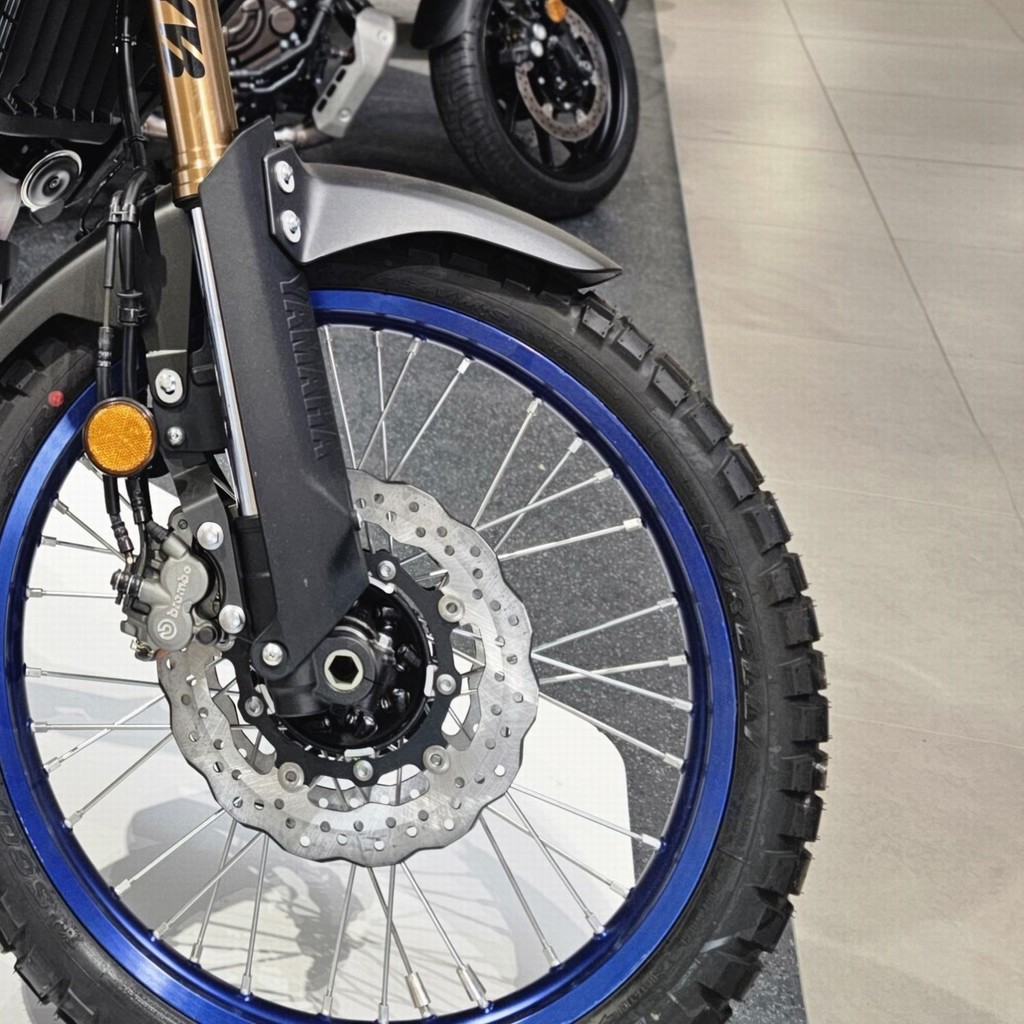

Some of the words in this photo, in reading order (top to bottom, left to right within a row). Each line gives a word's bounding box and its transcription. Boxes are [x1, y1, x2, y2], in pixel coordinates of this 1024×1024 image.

[279, 272, 339, 462] YAMAHA
[166, 565, 192, 618] brembo
[704, 529, 761, 750] PIRELLI
